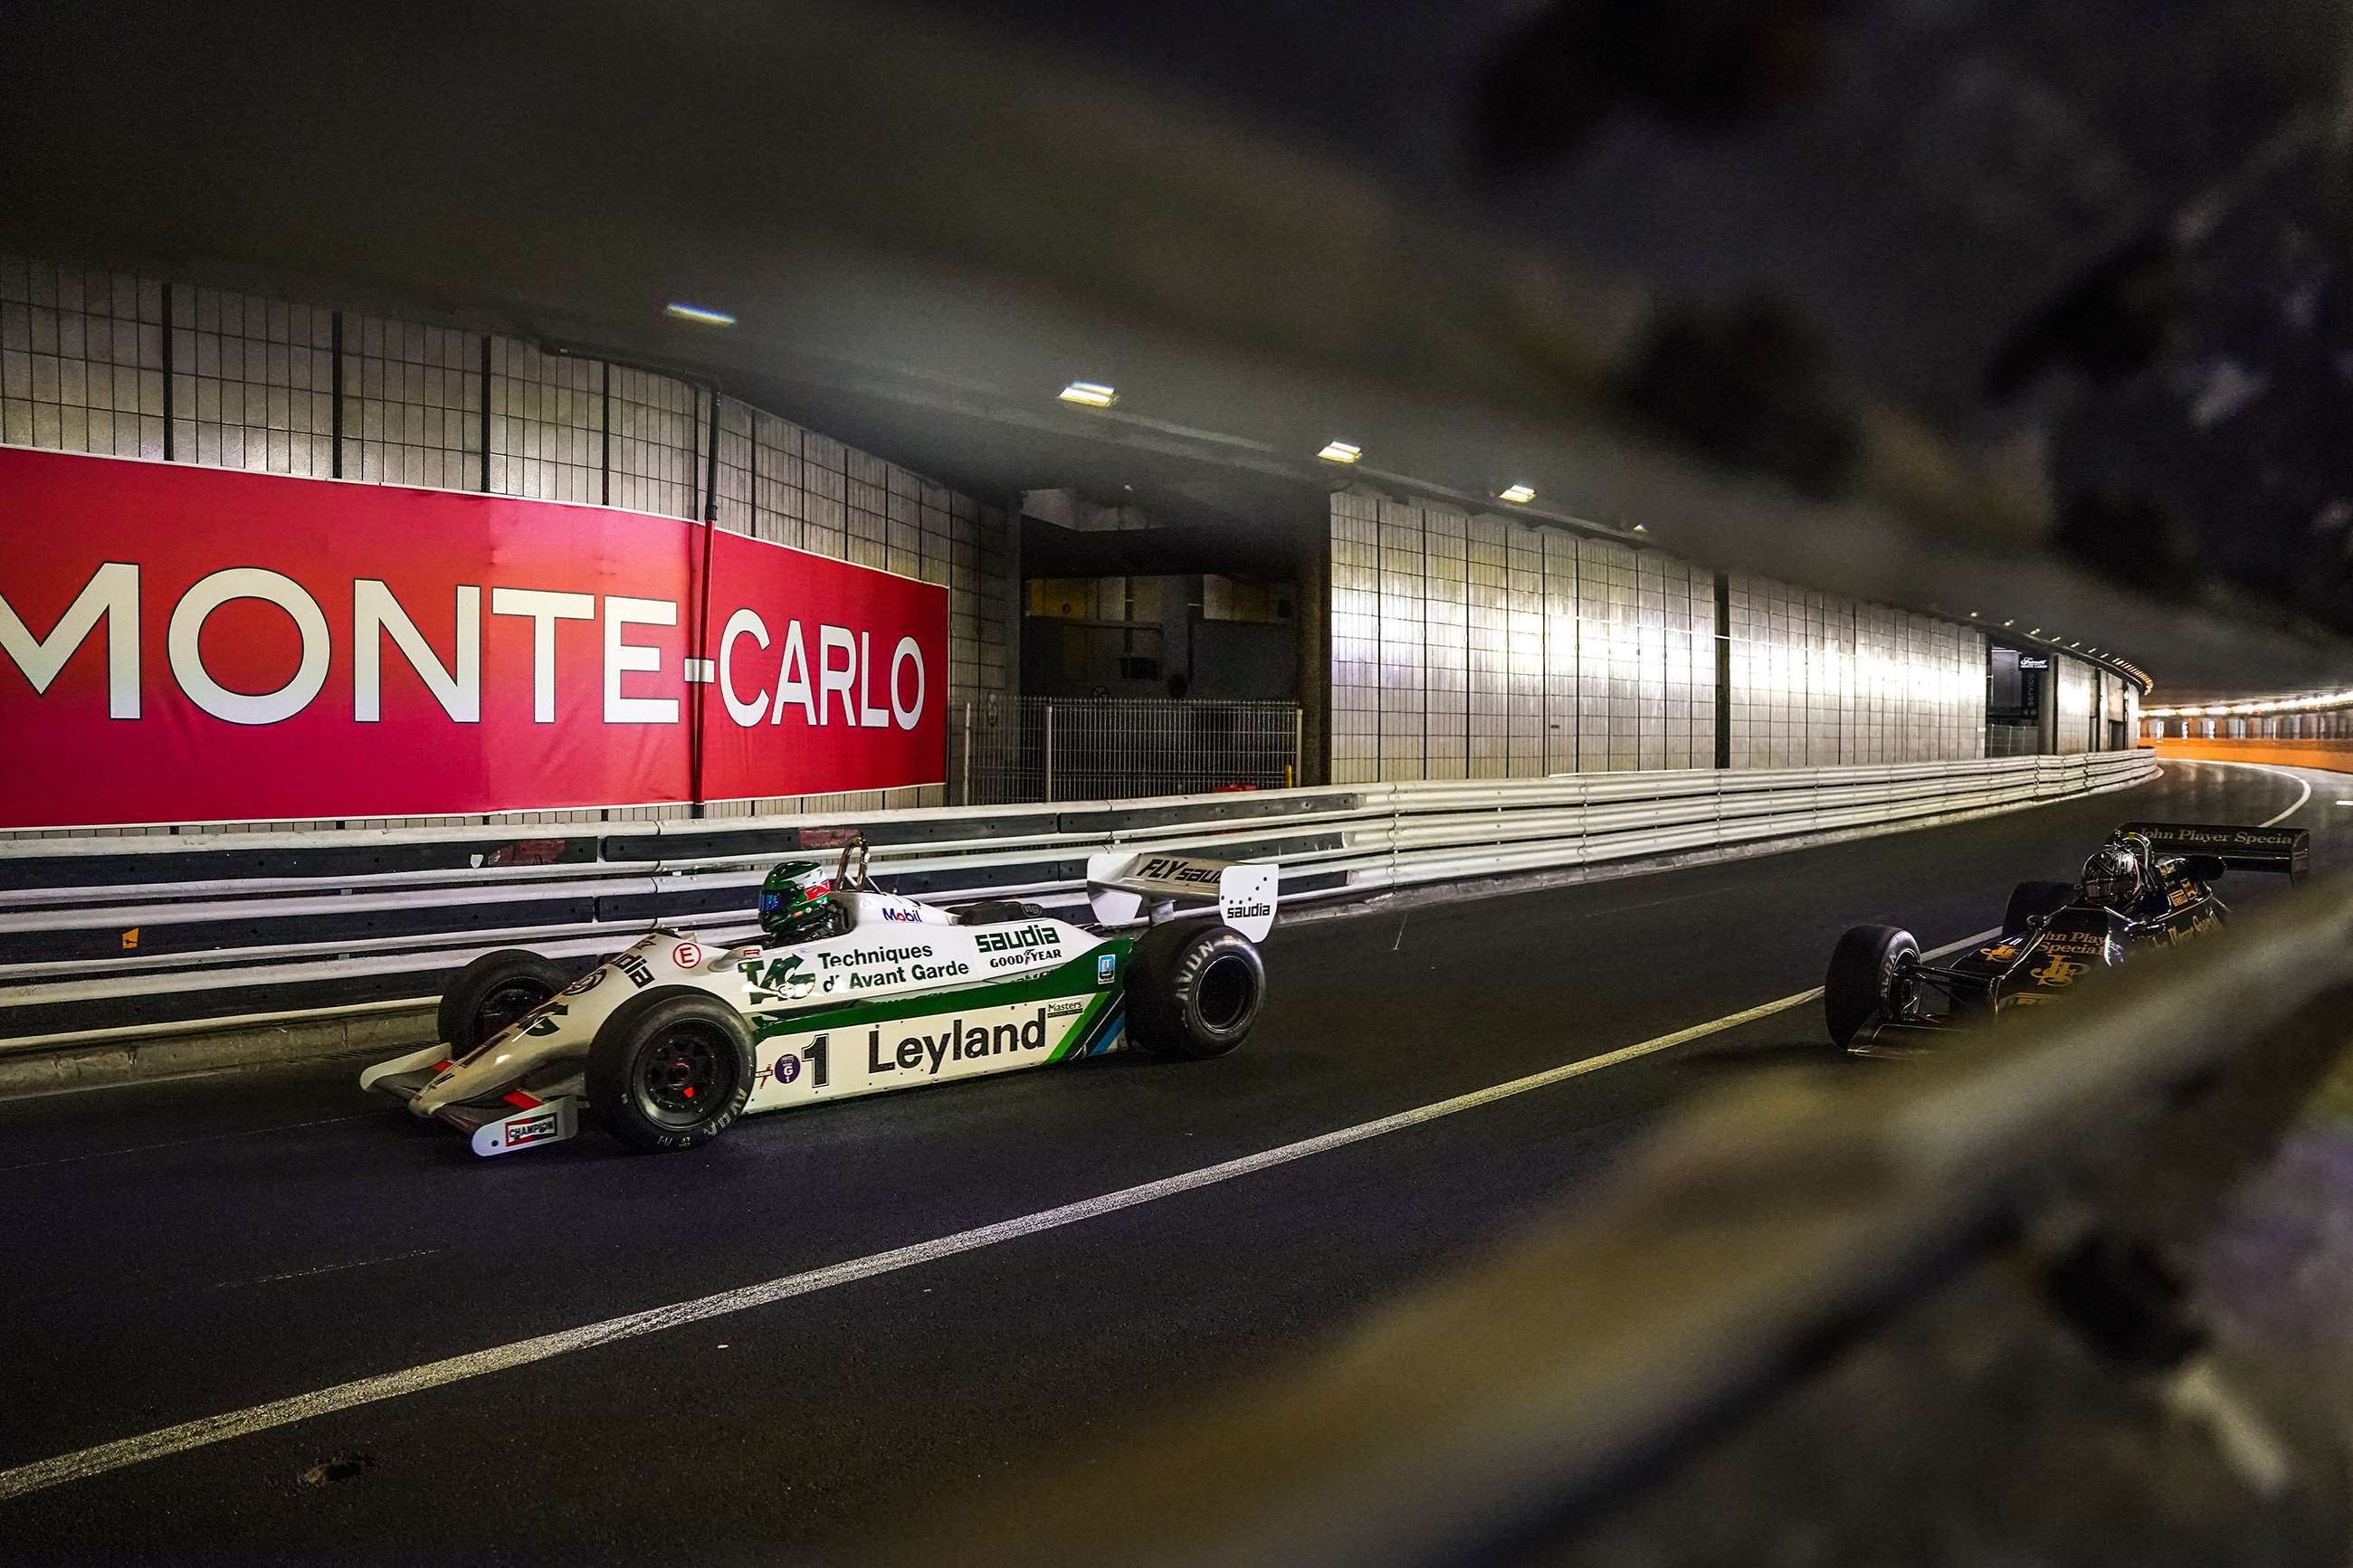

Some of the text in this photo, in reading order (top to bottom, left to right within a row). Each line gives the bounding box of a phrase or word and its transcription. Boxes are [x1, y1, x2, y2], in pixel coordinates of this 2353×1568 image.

[2177, 829, 2231, 842] Player
[1137, 859, 1222, 884] FLY sau
[882, 908, 923, 922] Mobil
[1227, 903, 1271, 918] saudia
[975, 925, 1061, 953] saudia
[818, 946, 933, 969] Techniques
[850, 966, 906, 989] Avant
[912, 960, 969, 982] Garde
[1047, 1002, 1082, 1013] Masters
[868, 1007, 1046, 1075] Leyland
[801, 1032, 830, 1088] 1
[783, 1066, 794, 1076] G
[508, 1120, 557, 1140] CHAMPION
